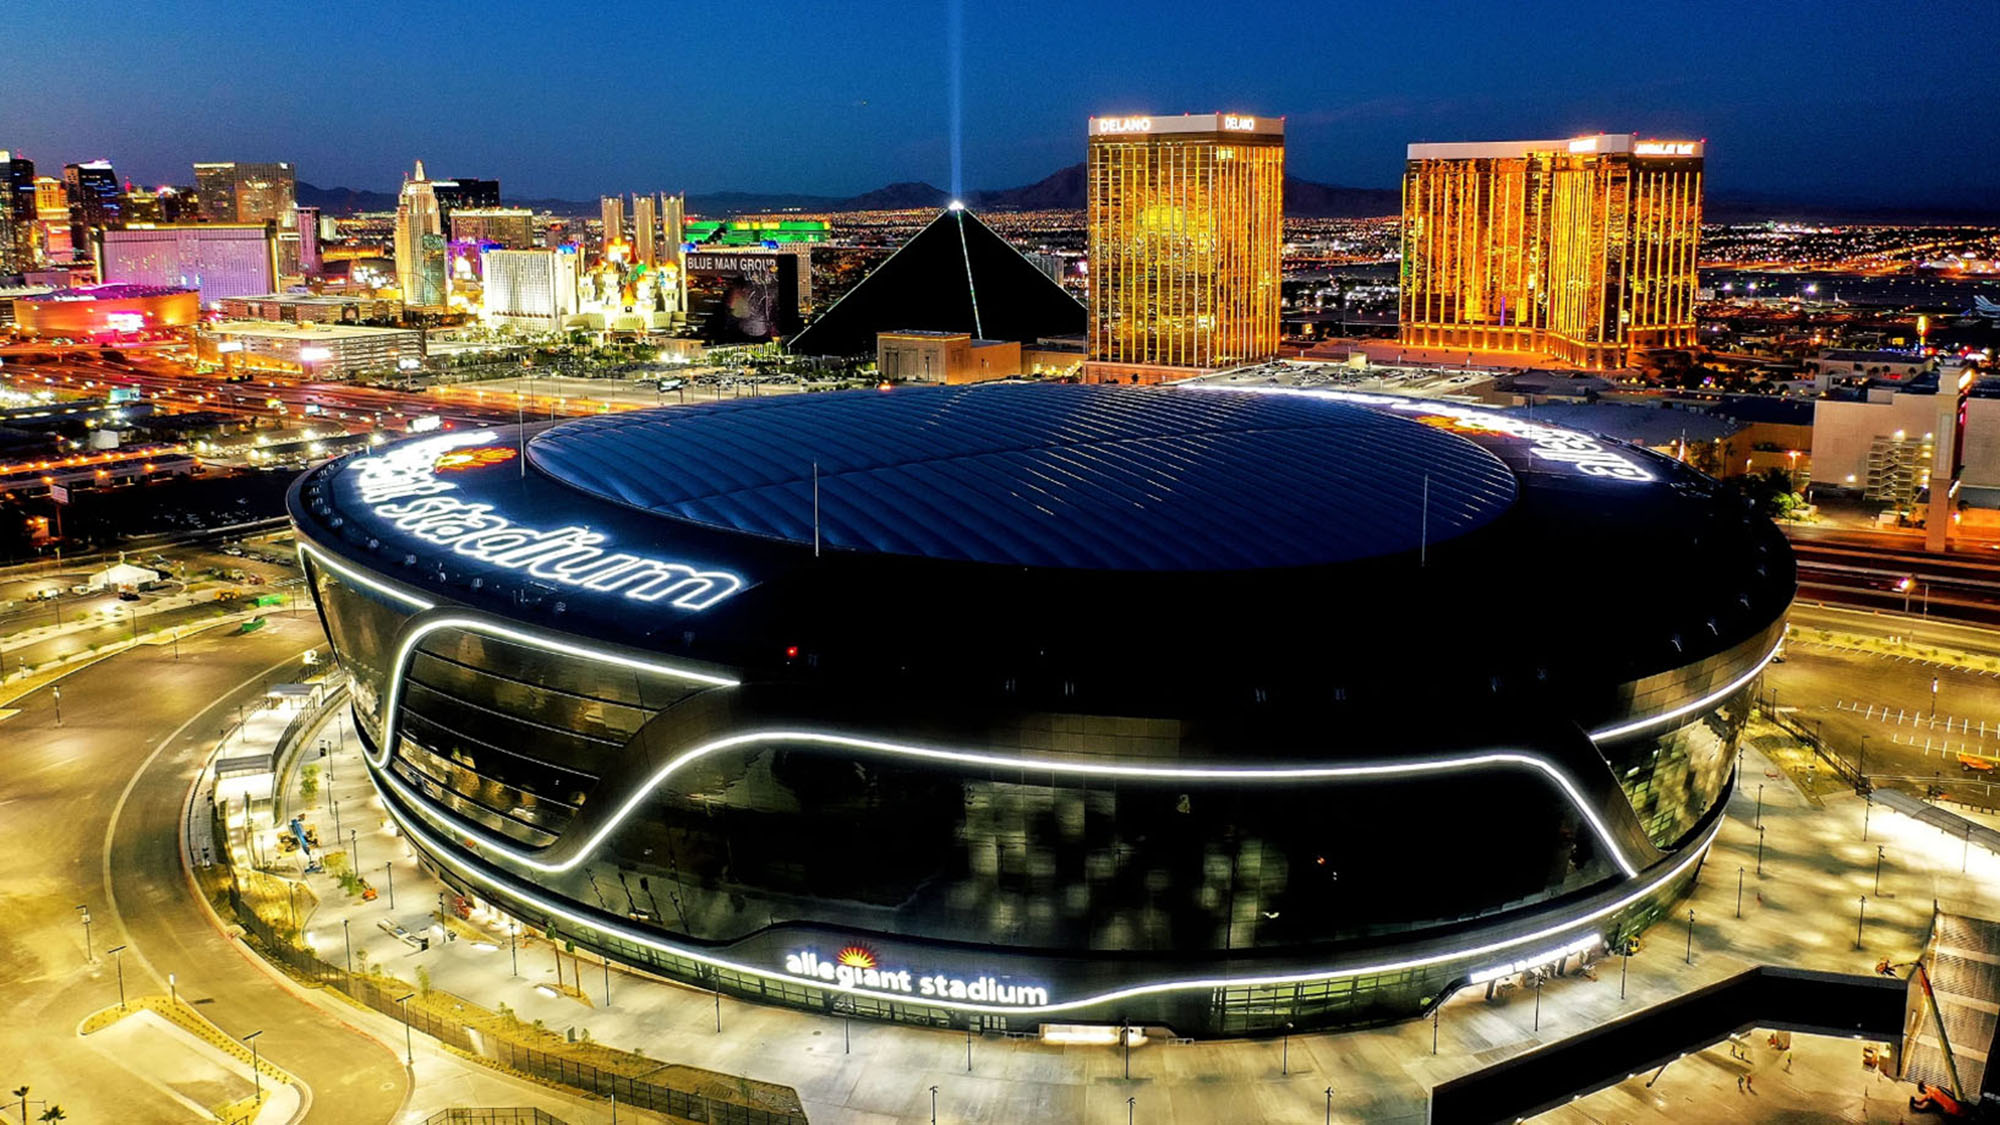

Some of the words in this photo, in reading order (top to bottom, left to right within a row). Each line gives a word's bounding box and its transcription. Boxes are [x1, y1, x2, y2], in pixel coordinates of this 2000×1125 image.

[1099, 118, 1152, 132] DELANO
[1224, 117, 1254, 130] DELANO
[687, 257, 713, 270] BLUE
[715, 257, 737, 270] MAN
[374, 496, 743, 611] stadium
[785, 950, 912, 988] allegiant
[919, 974, 1048, 1006] stadium
